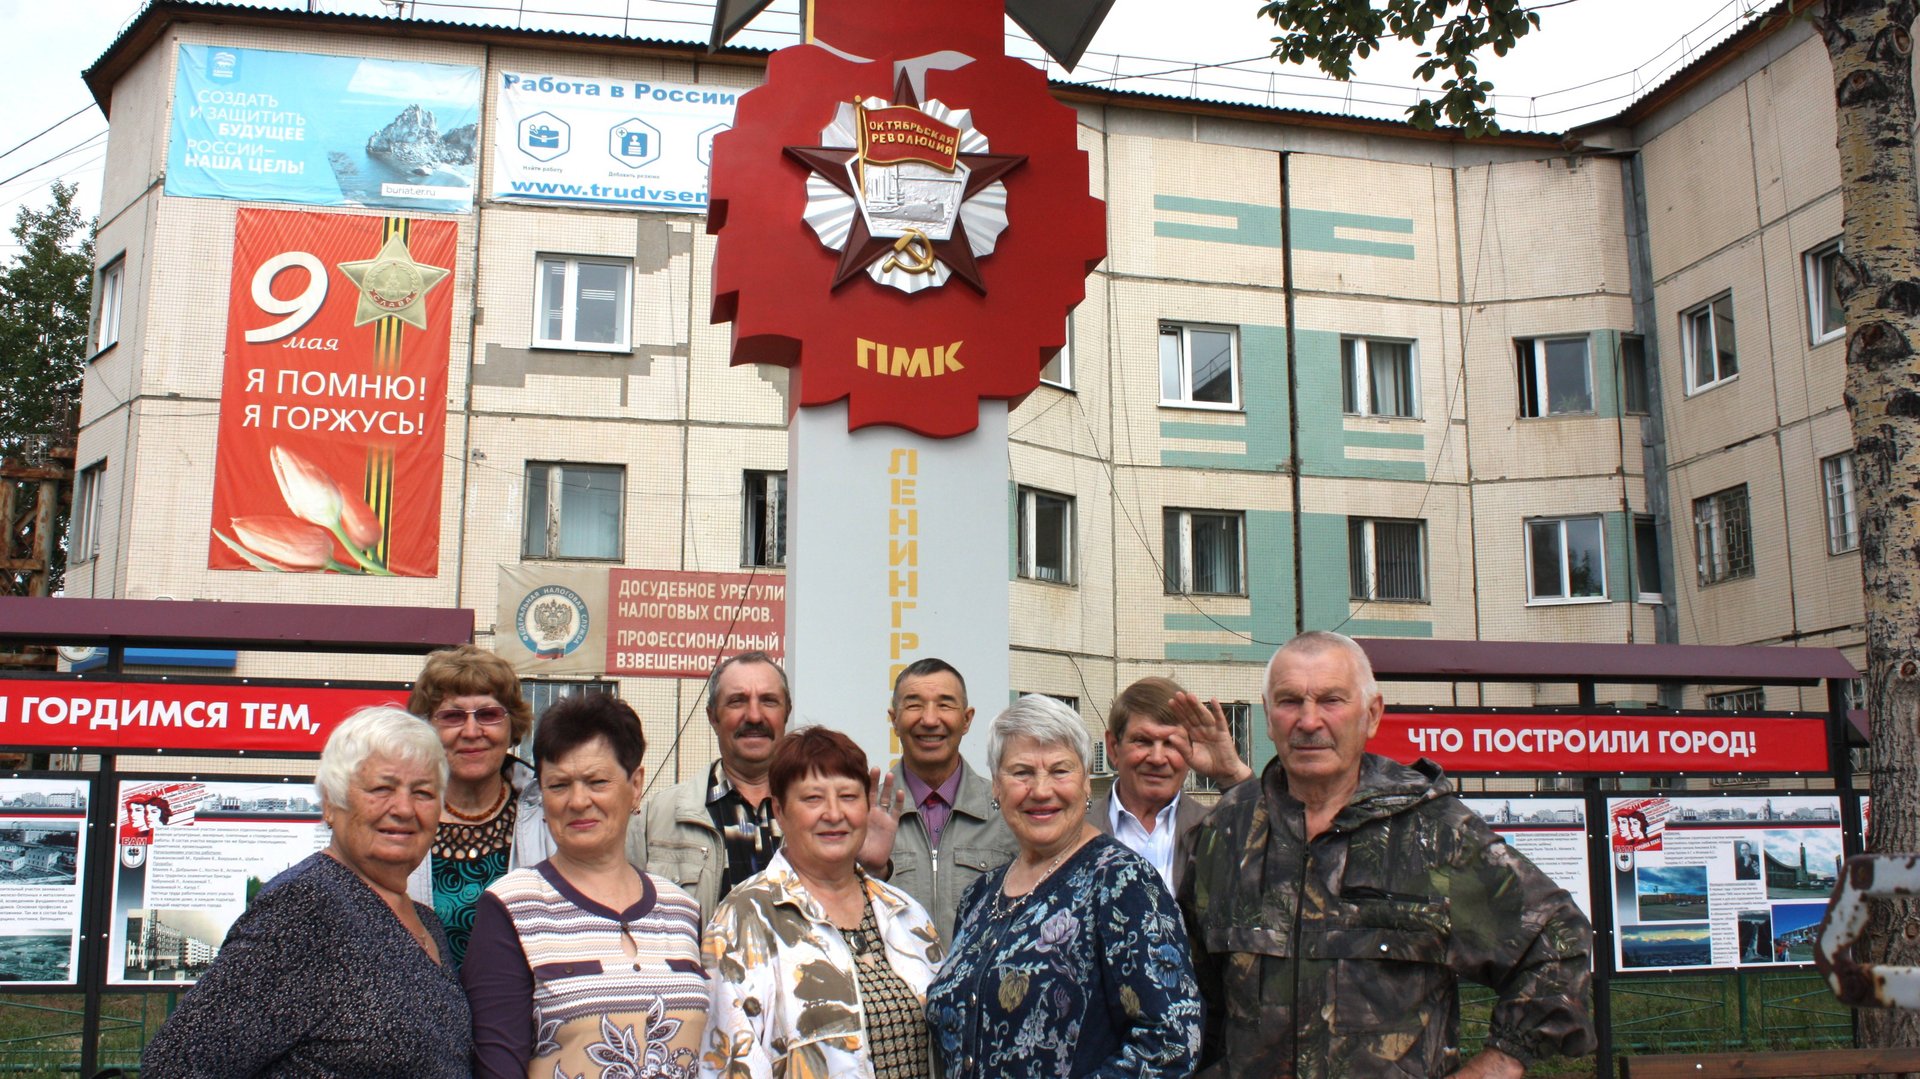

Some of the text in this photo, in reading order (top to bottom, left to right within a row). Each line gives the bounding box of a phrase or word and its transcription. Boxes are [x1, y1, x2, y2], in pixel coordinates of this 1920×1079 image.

[197, 89, 279, 108] СОЗДАТЬ
[504, 74, 736, 106] Работа в России
[189, 105, 306, 126] И ЗАЩИТИТЬ
[218, 122, 305, 142] БУДУЩЕЕ
[869, 120, 954, 145] ОКТЯБРЬСКАЯ
[871, 133, 953, 156] РЕВОЛЮЦИЯ
[184, 152, 305, 175] НАША ЦЕЛЬ!
[244, 251, 329, 343] 9
[282, 334, 339, 351] мая
[856, 337, 965, 378] ПМК
[244, 368, 426, 401] Я ПОМНЮ!
[242, 404, 424, 436] Я ГОРЖУСЬ!
[618, 580, 784, 601] ДОСУДЕБНОЕ УРЕГУЛИ
[518, 587, 588, 644] ФЕДЕРАЛЬНАЯ НАЛОГОВАЯ СЛУЖБА
[618, 602, 775, 622] НАЛОГОВЫХ СПОРОВ.
[617, 630, 779, 651] ПРОФЕССИОНАЛЬНЫЙ
[616, 652, 717, 671] ВЗВЕШЕННОЕ
[21, 697, 228, 731] ГОРДИМСЯ
[241, 703, 321, 735] ТЕМ,
[1408, 728, 1757, 758] ЧТО ПОСТРОИЛИ ГОРОД!
